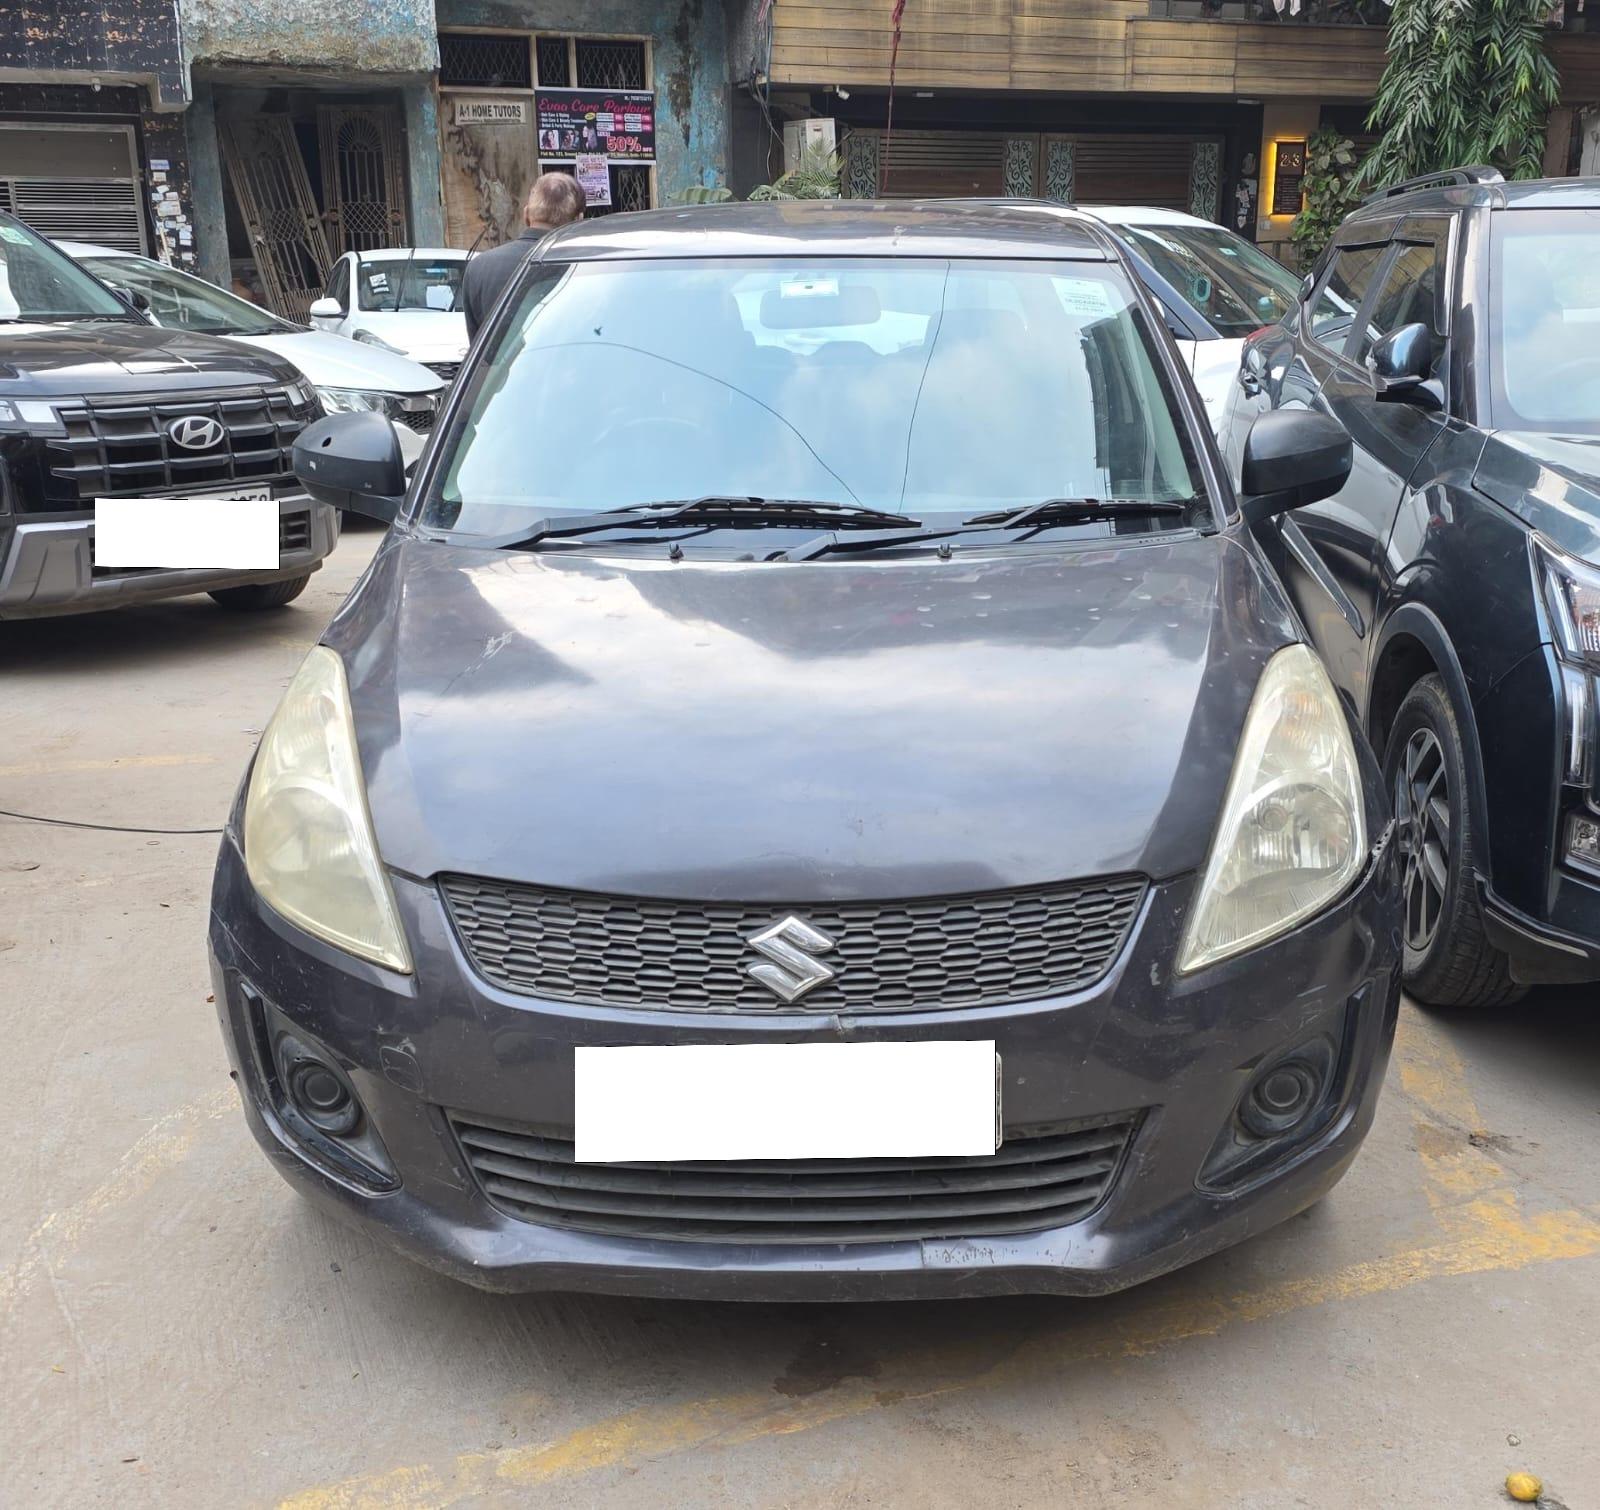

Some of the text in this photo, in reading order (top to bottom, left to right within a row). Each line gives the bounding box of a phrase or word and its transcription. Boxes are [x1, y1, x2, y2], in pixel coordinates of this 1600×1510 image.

[459, 104, 521, 118] A-1 HOME TUTORS
[572, 99, 600, 112] Care
[603, 99, 651, 113] Parlour
[607, 136, 642, 152] 50%
